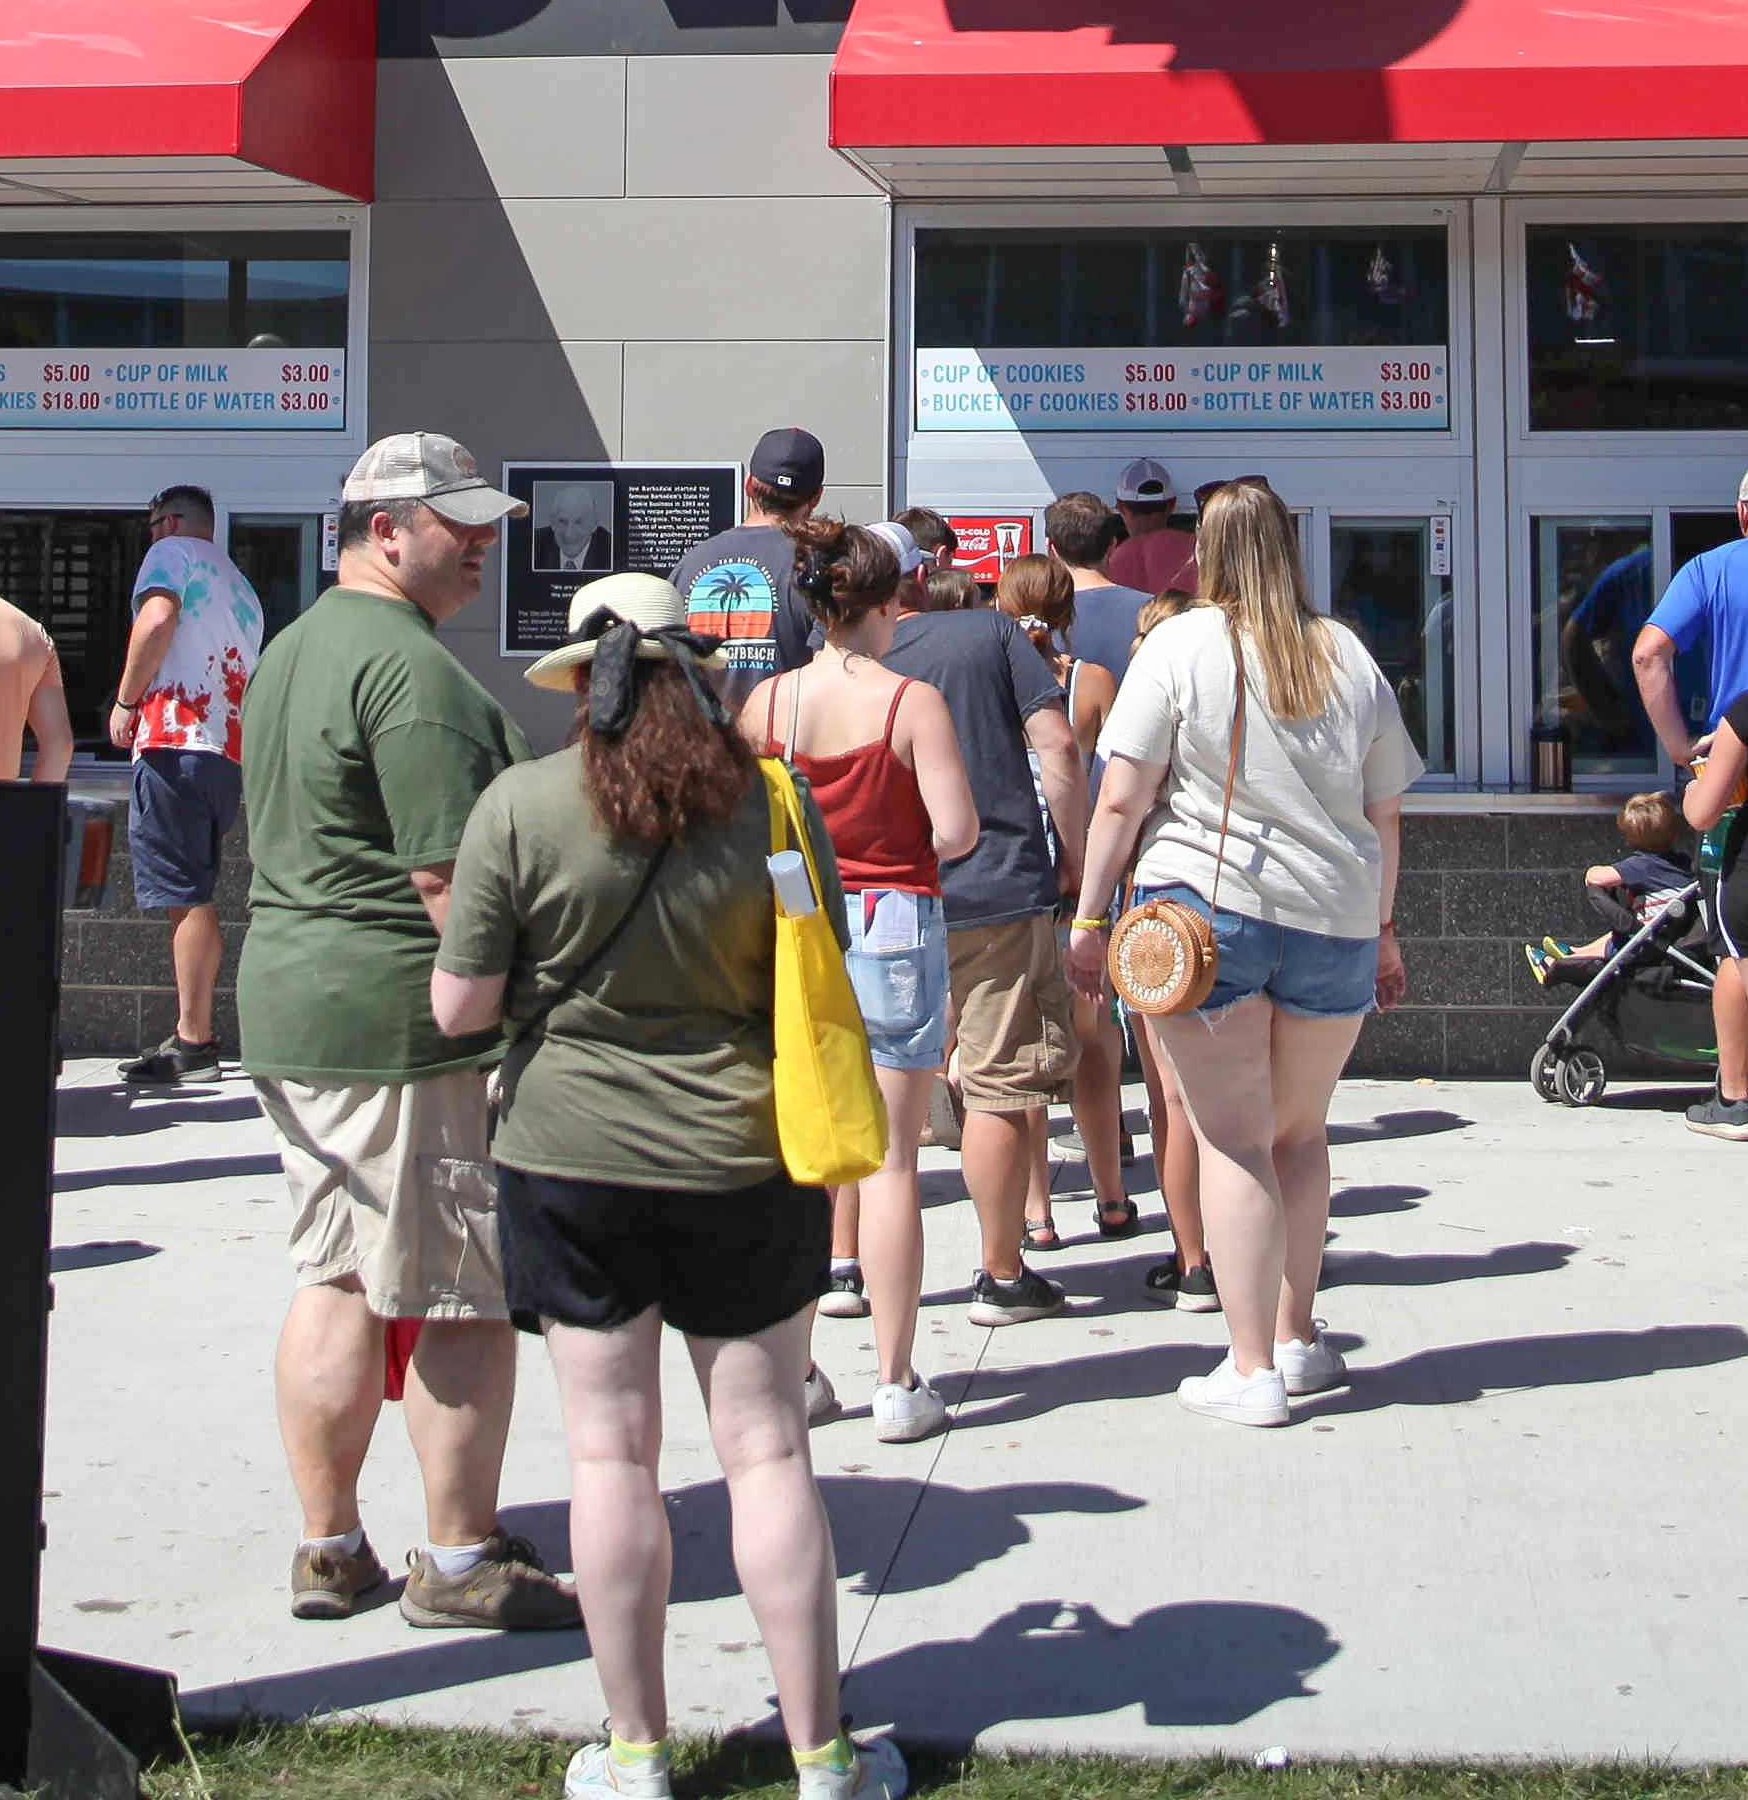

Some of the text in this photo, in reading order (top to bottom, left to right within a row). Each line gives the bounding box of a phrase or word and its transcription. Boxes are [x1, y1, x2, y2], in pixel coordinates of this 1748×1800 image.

[43, 364, 90, 383] $5.00
[116, 364, 151, 382] CUP
[157, 364, 179, 382] OF
[186, 364, 228, 382] MILK
[281, 364, 329, 383] $3.00
[933, 362, 1431, 384] CUP OF COOKIES $5.00 CUP OF MILK $3.00
[42, 391, 100, 411] $18.00
[115, 392, 179, 409] BOTTLE
[185, 392, 207, 409] OF
[214, 392, 275, 410] WATER
[281, 392, 328, 411] $3.00
[933, 391, 1431, 412] BUCKET OF COOKIES $18.00 BOTTLE OF WATER $3.00
[954, 528, 991, 536] CE-COLD
